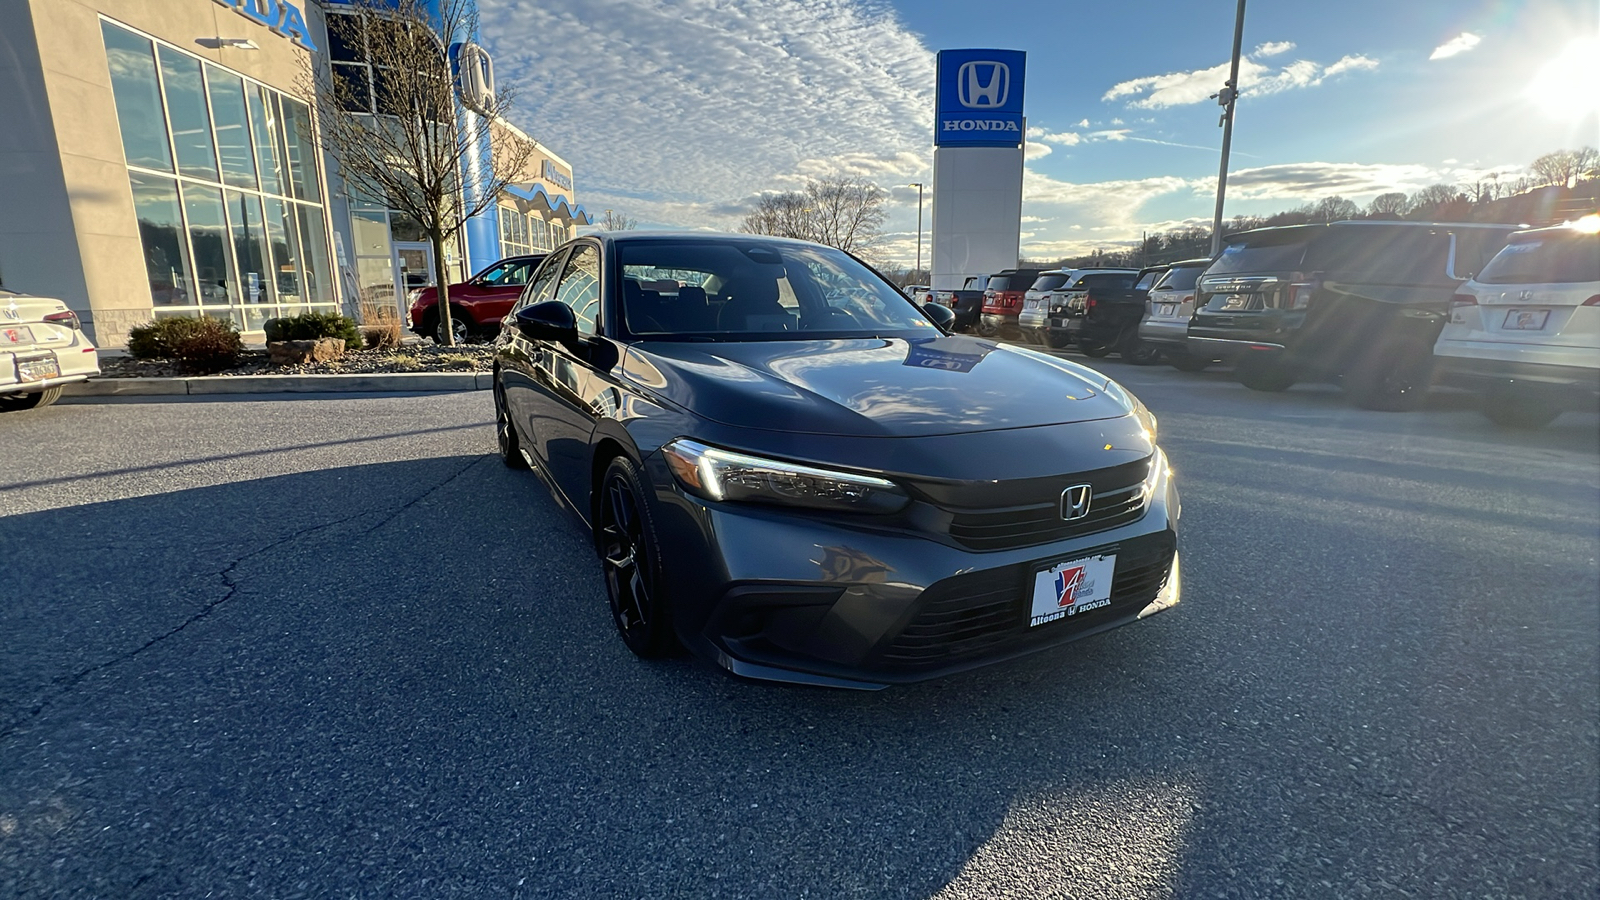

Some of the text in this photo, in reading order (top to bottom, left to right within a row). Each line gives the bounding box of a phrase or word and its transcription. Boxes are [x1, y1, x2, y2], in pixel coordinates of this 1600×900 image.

[943, 120, 1020, 131] HONDA
[1030, 611, 1065, 627] Altoona
[1079, 599, 1111, 613] HONDA
